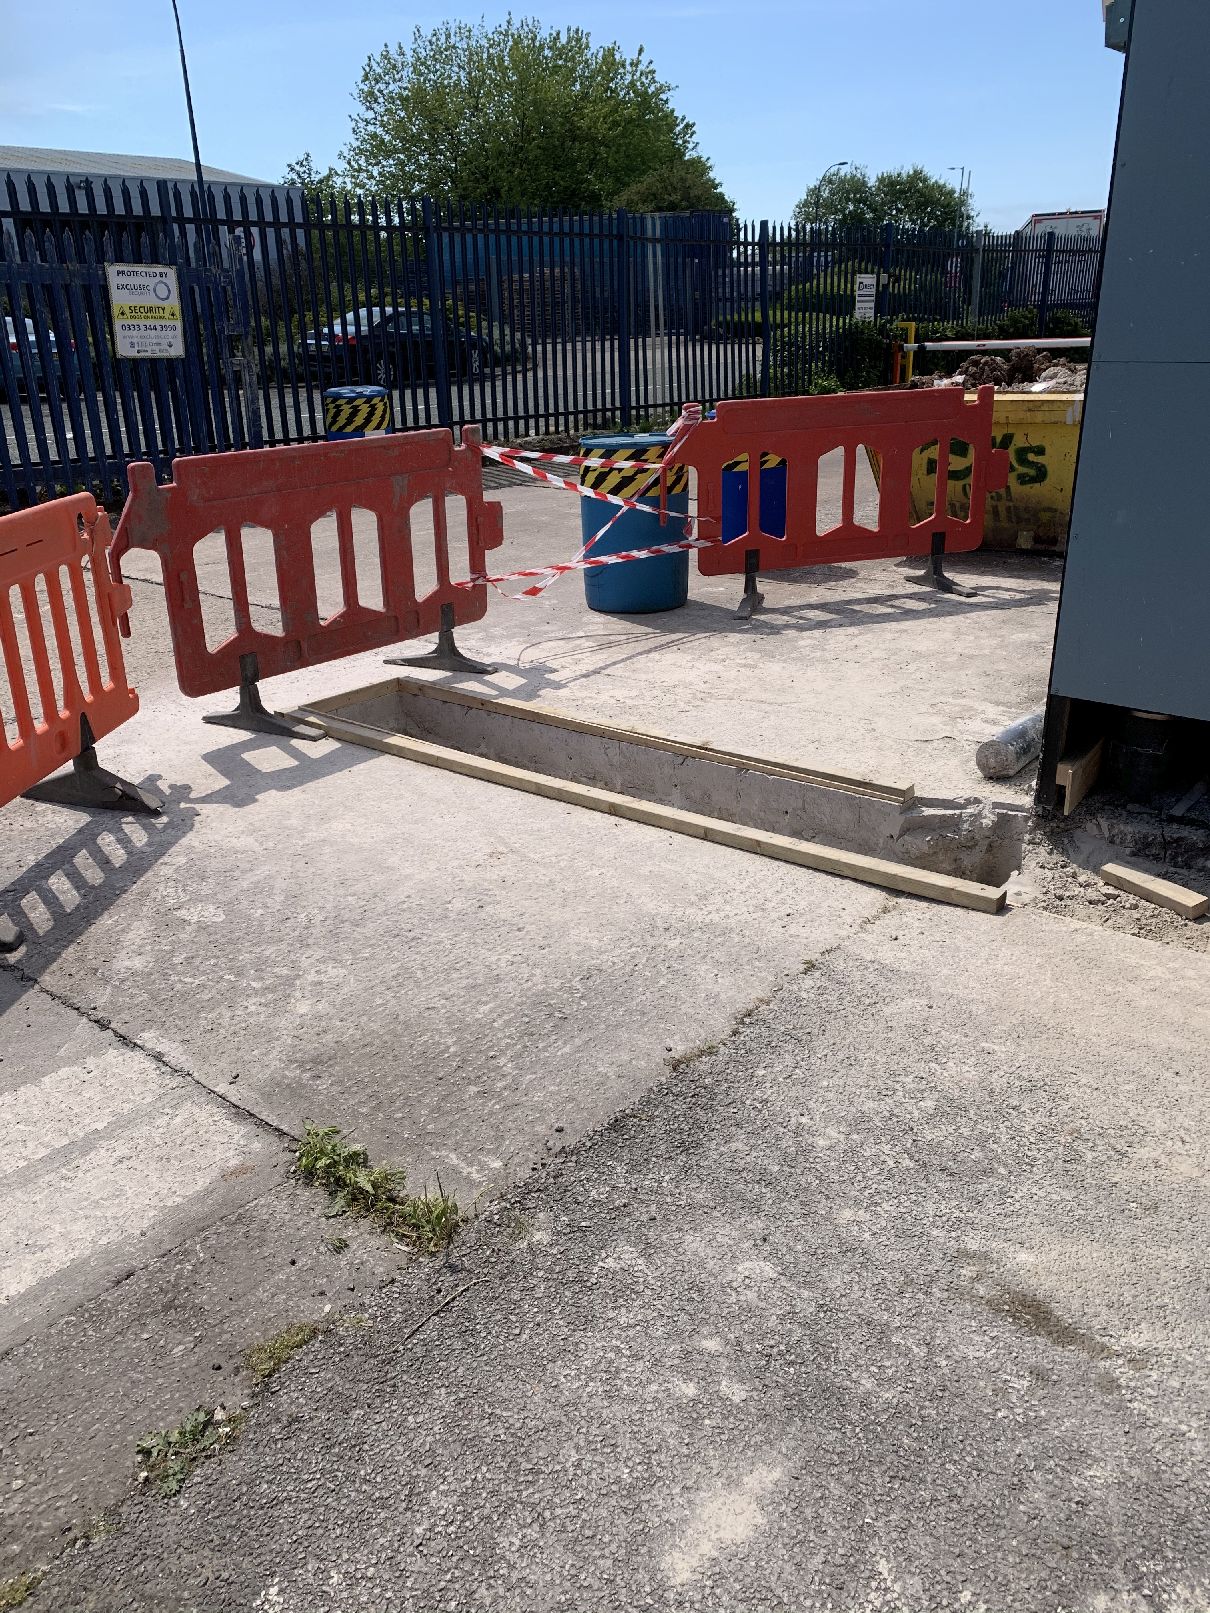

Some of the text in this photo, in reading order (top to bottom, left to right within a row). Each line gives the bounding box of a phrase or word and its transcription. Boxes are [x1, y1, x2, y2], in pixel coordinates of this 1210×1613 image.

[116, 269, 158, 278] PROTECTED
[116, 283, 150, 291] EXCLUSEC
[128, 305, 166, 315] SECURITY
[159, 324, 177, 332] 3990
